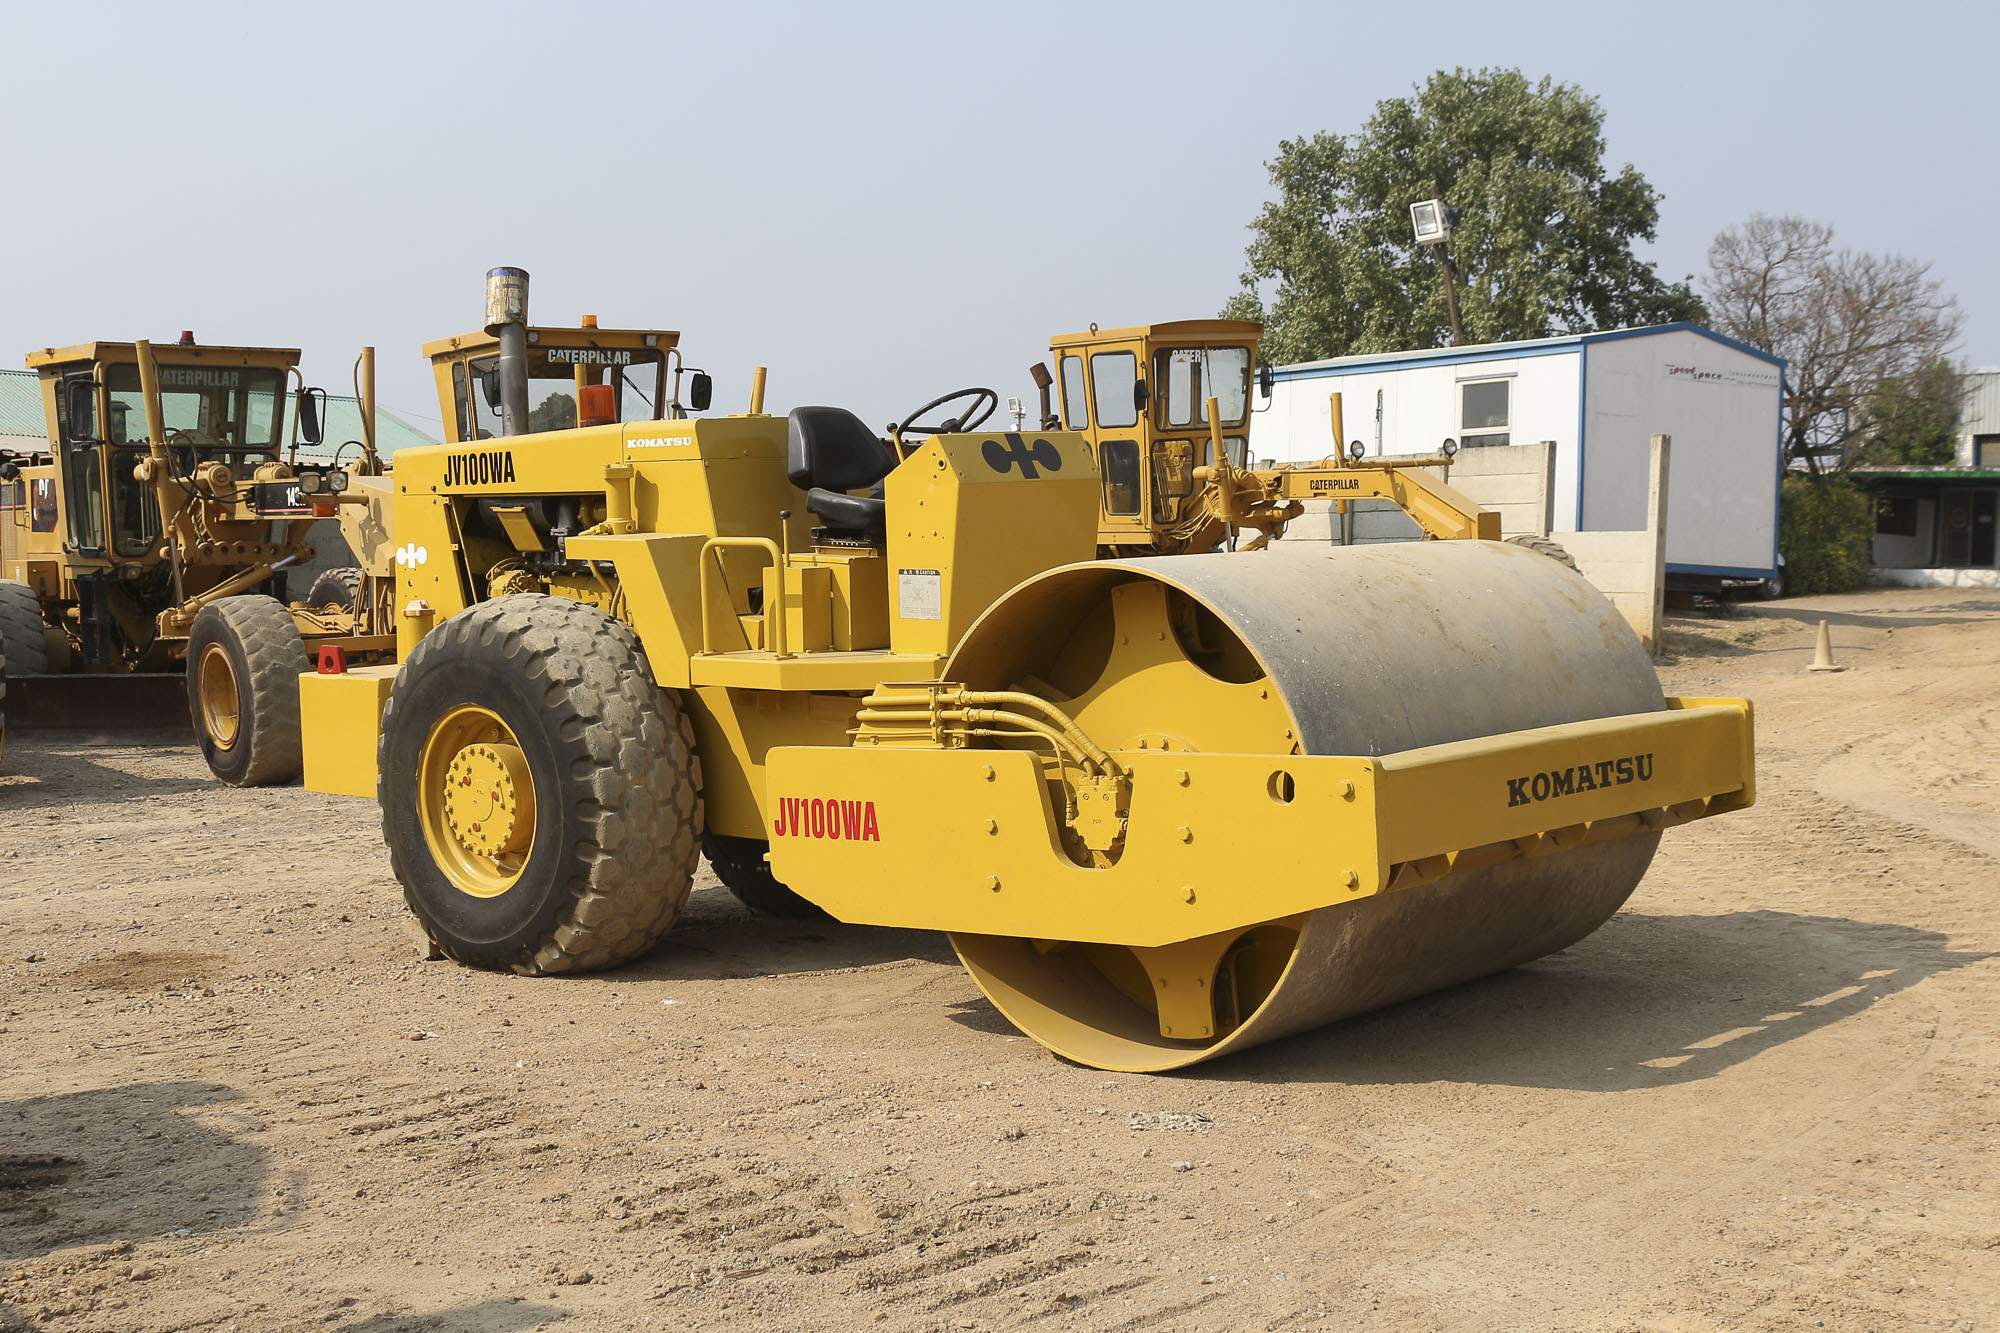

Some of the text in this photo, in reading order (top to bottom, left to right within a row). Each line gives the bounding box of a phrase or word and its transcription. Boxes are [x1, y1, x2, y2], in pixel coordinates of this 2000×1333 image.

[548, 349, 631, 364] CATERPILLAR
[159, 368, 239, 387] ATERPILLAR
[627, 436, 693, 449] KOMATSU
[444, 451, 516, 487] JV100WA
[1310, 479, 1360, 490] CATERPILLAR
[1506, 753, 1653, 808] KOMATSU
[774, 797, 880, 842] JV100WA
